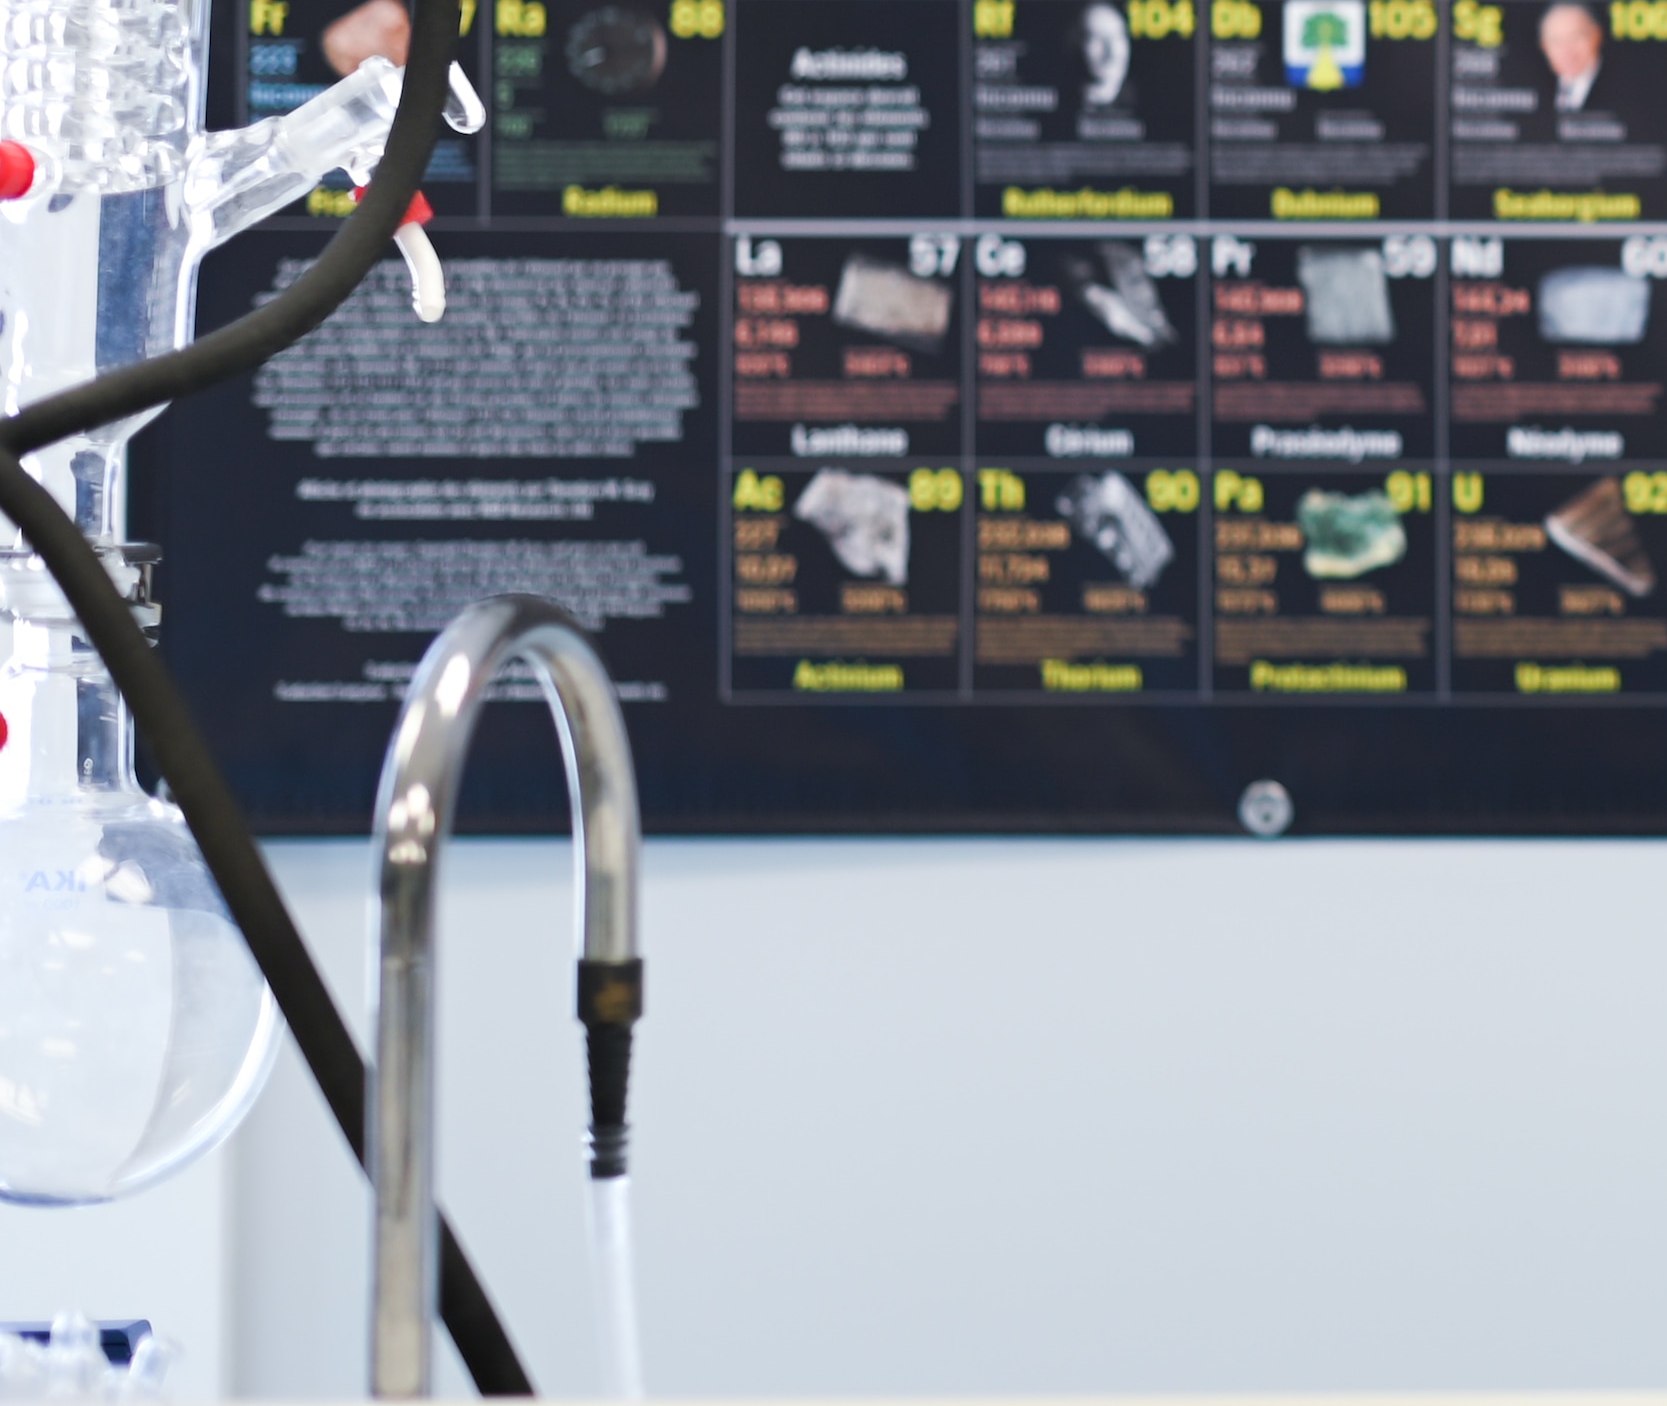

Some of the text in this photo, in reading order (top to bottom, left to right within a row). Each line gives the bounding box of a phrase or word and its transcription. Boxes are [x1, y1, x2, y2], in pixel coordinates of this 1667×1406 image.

[735, 237, 783, 275] La
[975, 237, 1026, 276] Ce
[1211, 239, 1258, 275] Pr
[1452, 238, 1503, 277] Nd
[734, 469, 781, 510] Ac
[979, 469, 1024, 508] Th
[1145, 470, 1199, 511] 90
[1214, 470, 1262, 511] Pa
[1453, 473, 1482, 512] U
